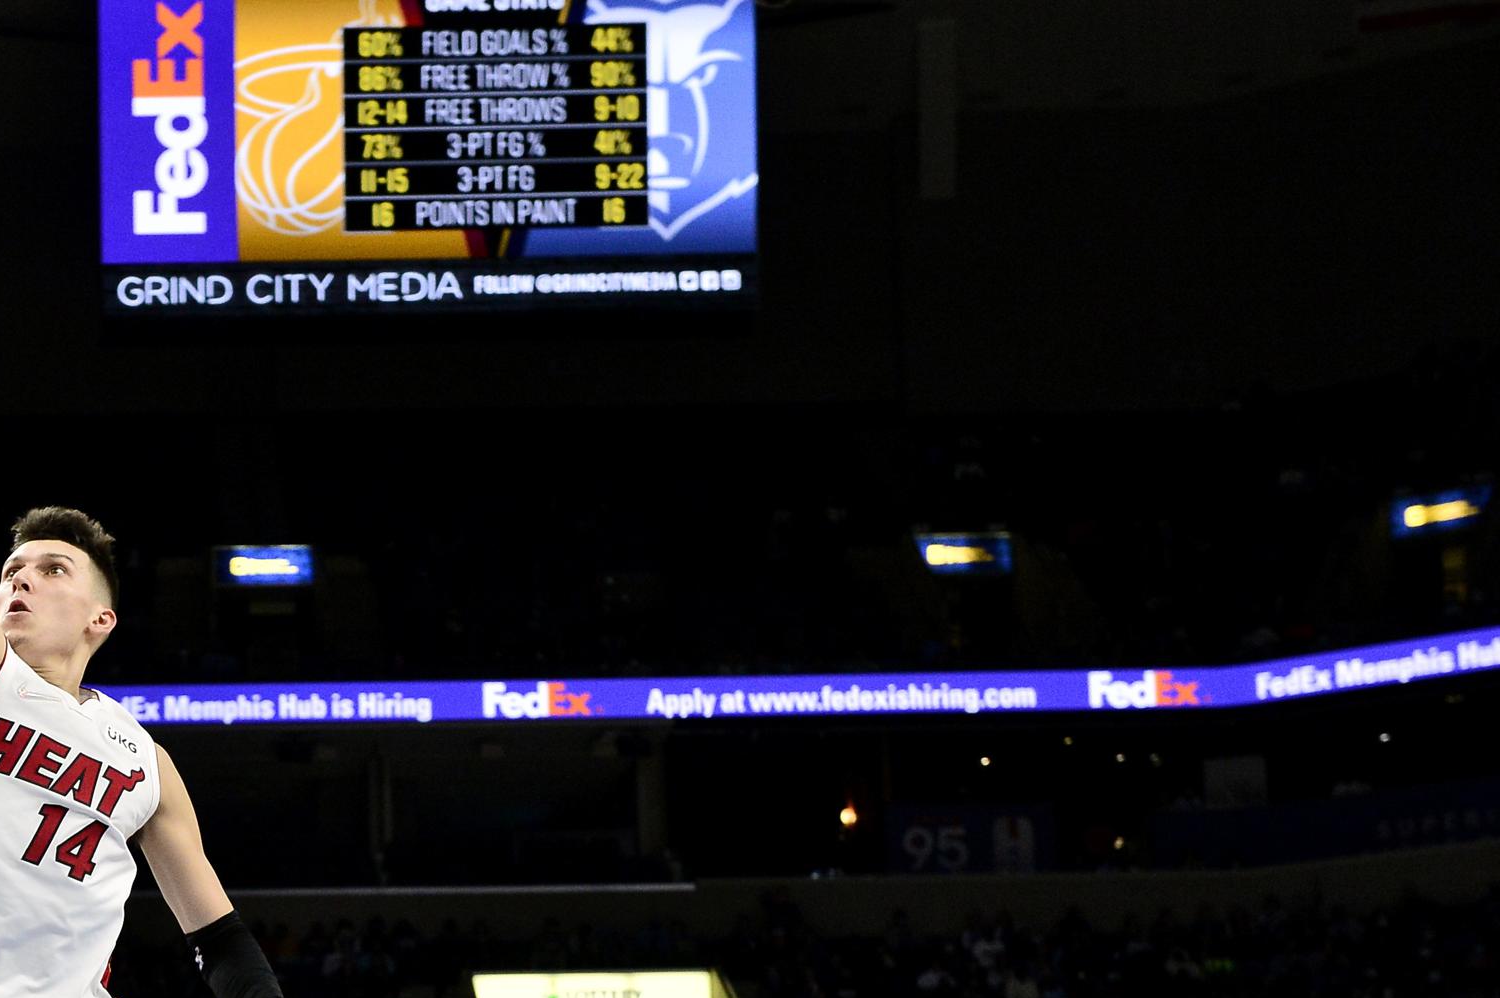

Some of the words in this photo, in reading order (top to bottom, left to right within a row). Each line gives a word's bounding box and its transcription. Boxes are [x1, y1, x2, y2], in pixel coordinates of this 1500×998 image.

[422, 30, 477, 57] FIELD
[480, 29, 548, 56] GOALS
[421, 65, 472, 91] FREE
[475, 63, 549, 90] THROW
[132, 0, 209, 235] FedEx
[425, 99, 476, 125] FREE
[479, 97, 567, 124] THROWS
[446, 132, 495, 159] 3-PT
[497, 132, 525, 158] FG
[457, 166, 504, 193] 3-PT
[507, 165, 536, 191] FG
[415, 200, 490, 227] POINTS
[492, 200, 515, 226] IN
[517, 198, 577, 225] PAINT
[117, 275, 235, 307] GRIND
[246, 274, 336, 305] CITY
[348, 272, 464, 303] MEDIA
[1087, 670, 1199, 709] FedEx
[1255, 664, 1332, 701] FedEx
[1334, 647, 1455, 688] Memphis
[163, 694, 277, 725] Memphis
[279, 693, 329, 720] Hub
[331, 693, 356, 720] is
[358, 692, 434, 723] Hiring
[482, 681, 591, 720] FedEx
[646, 687, 717, 720] Apply
[720, 689, 746, 715] at
[748, 683, 1038, 715] www.fedexishiring.com
[21, 802, 110, 883] 14
